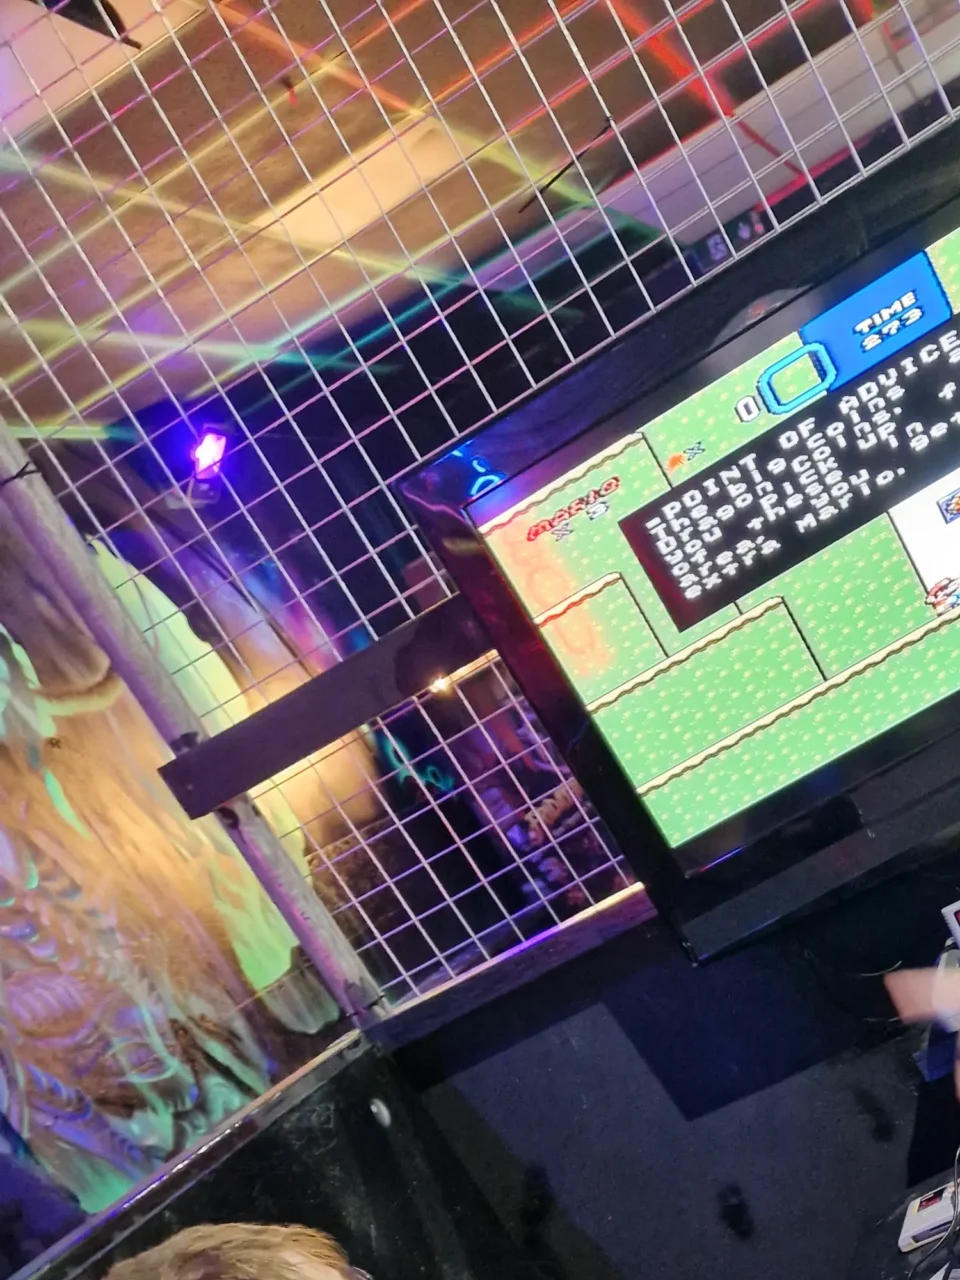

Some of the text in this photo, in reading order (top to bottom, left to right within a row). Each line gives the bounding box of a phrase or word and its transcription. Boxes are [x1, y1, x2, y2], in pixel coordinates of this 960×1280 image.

[853, 290, 915, 334] TIME
[861, 307, 924, 352] 273
[648, 498, 708, 545] The
[725, 457, 786, 499] big
[805, 384, 905, 449] coins
[655, 478, 773, 556] Dragon
[790, 396, 902, 473] Coins.
[777, 416, 815, 449] OF
[525, 475, 621, 542] MARIO
[663, 526, 722, 565] you
[758, 456, 838, 511] pick
[856, 421, 896, 450] up
[670, 547, 707, 576] of
[746, 469, 843, 530] these
[885, 421, 923, 448] in
[683, 467, 905, 599] extra Mario.
[809, 468, 870, 509] you
